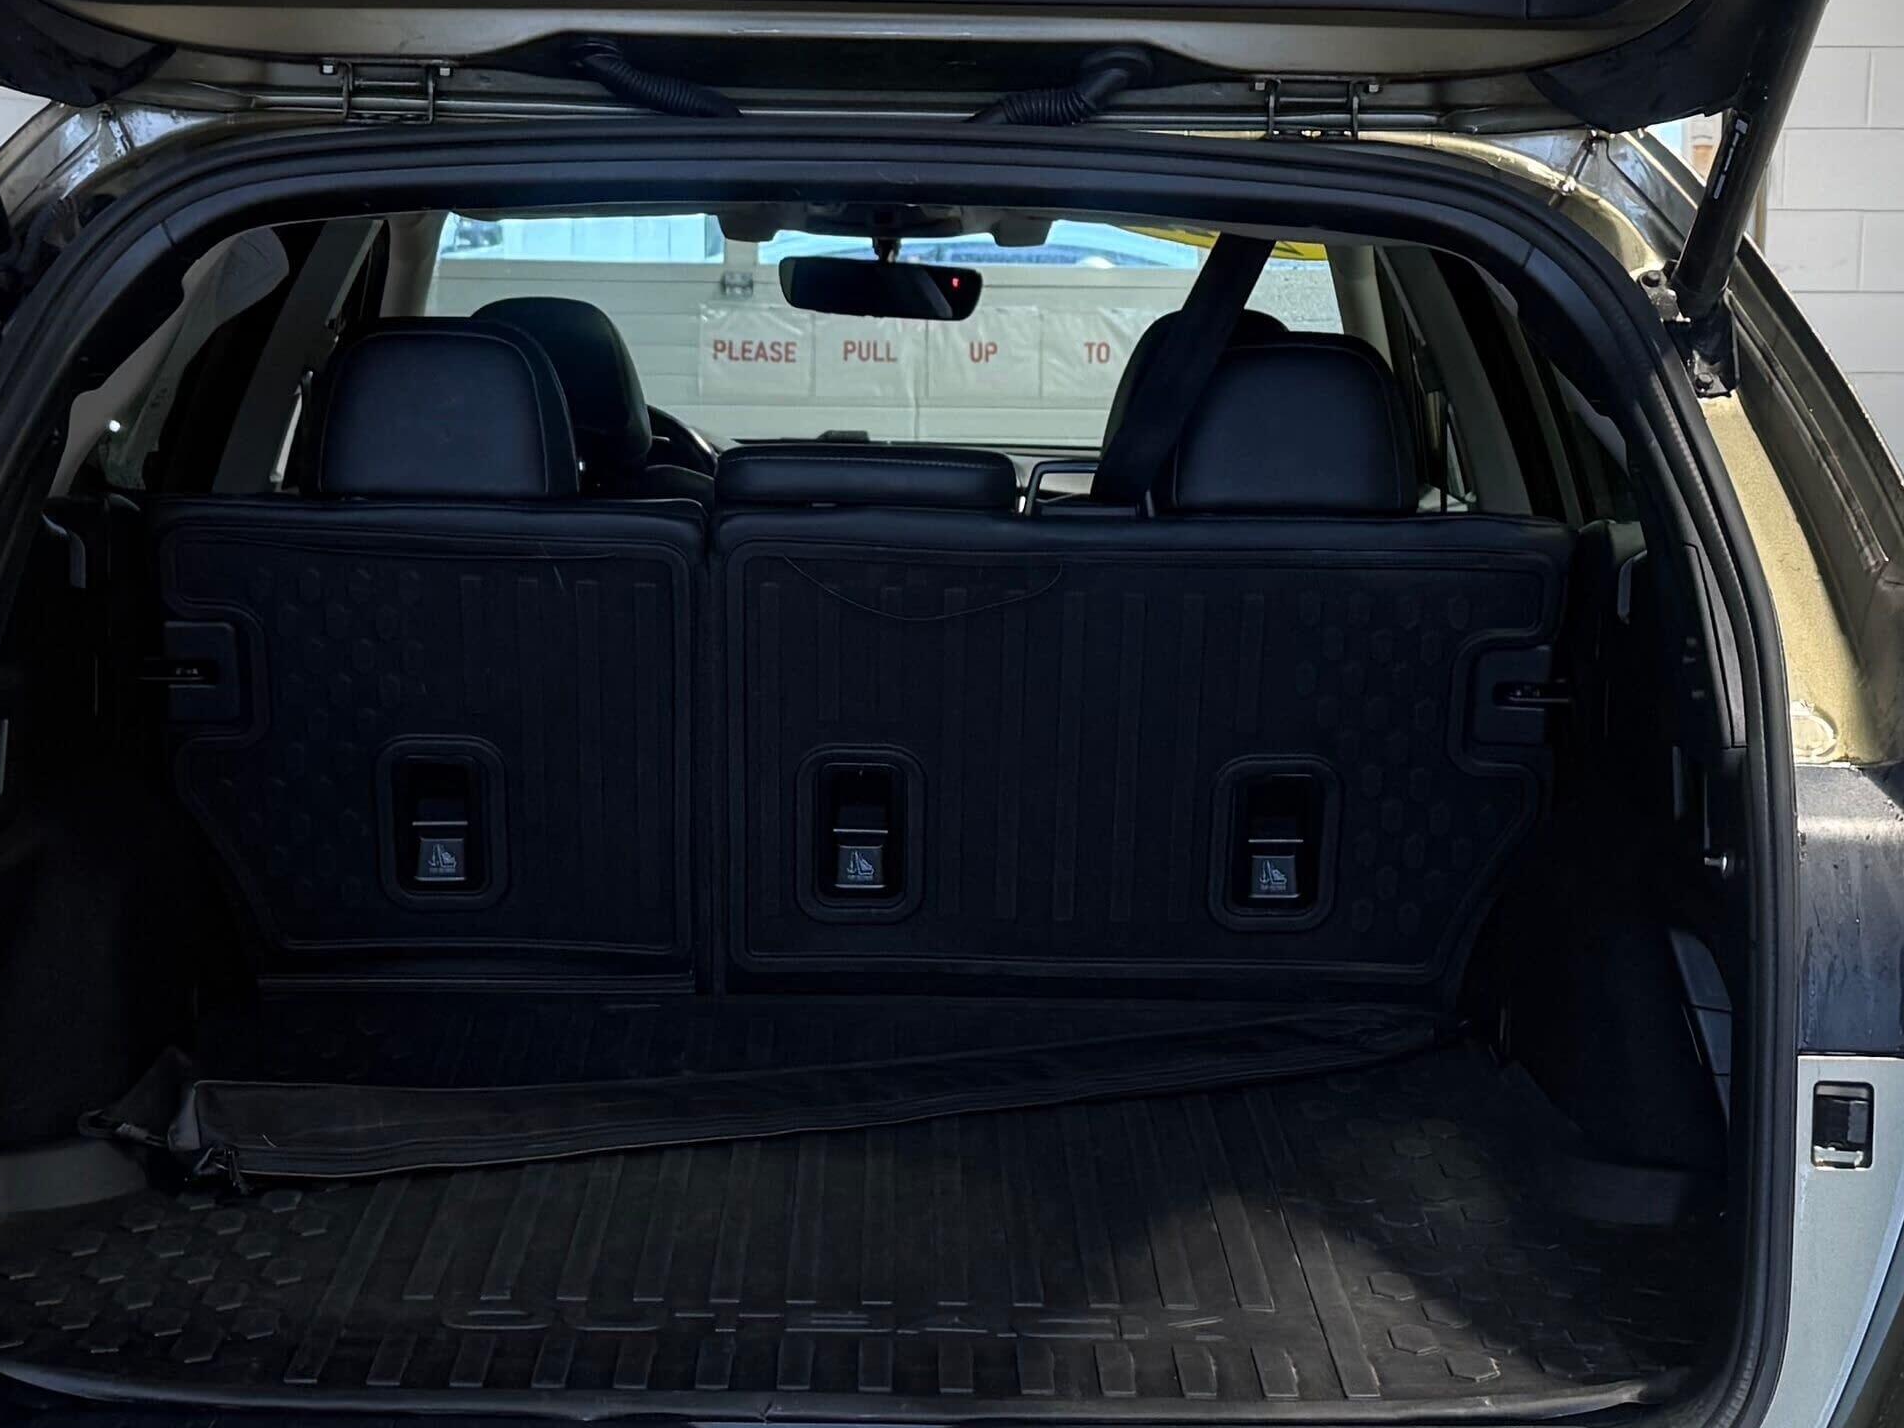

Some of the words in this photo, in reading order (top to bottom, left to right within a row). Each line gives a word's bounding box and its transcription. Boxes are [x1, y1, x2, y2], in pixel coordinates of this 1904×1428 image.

[712, 339, 797, 363] PLEASE
[842, 340, 897, 363] PULL
[969, 341, 998, 363] UP
[1084, 341, 1111, 363] TO
